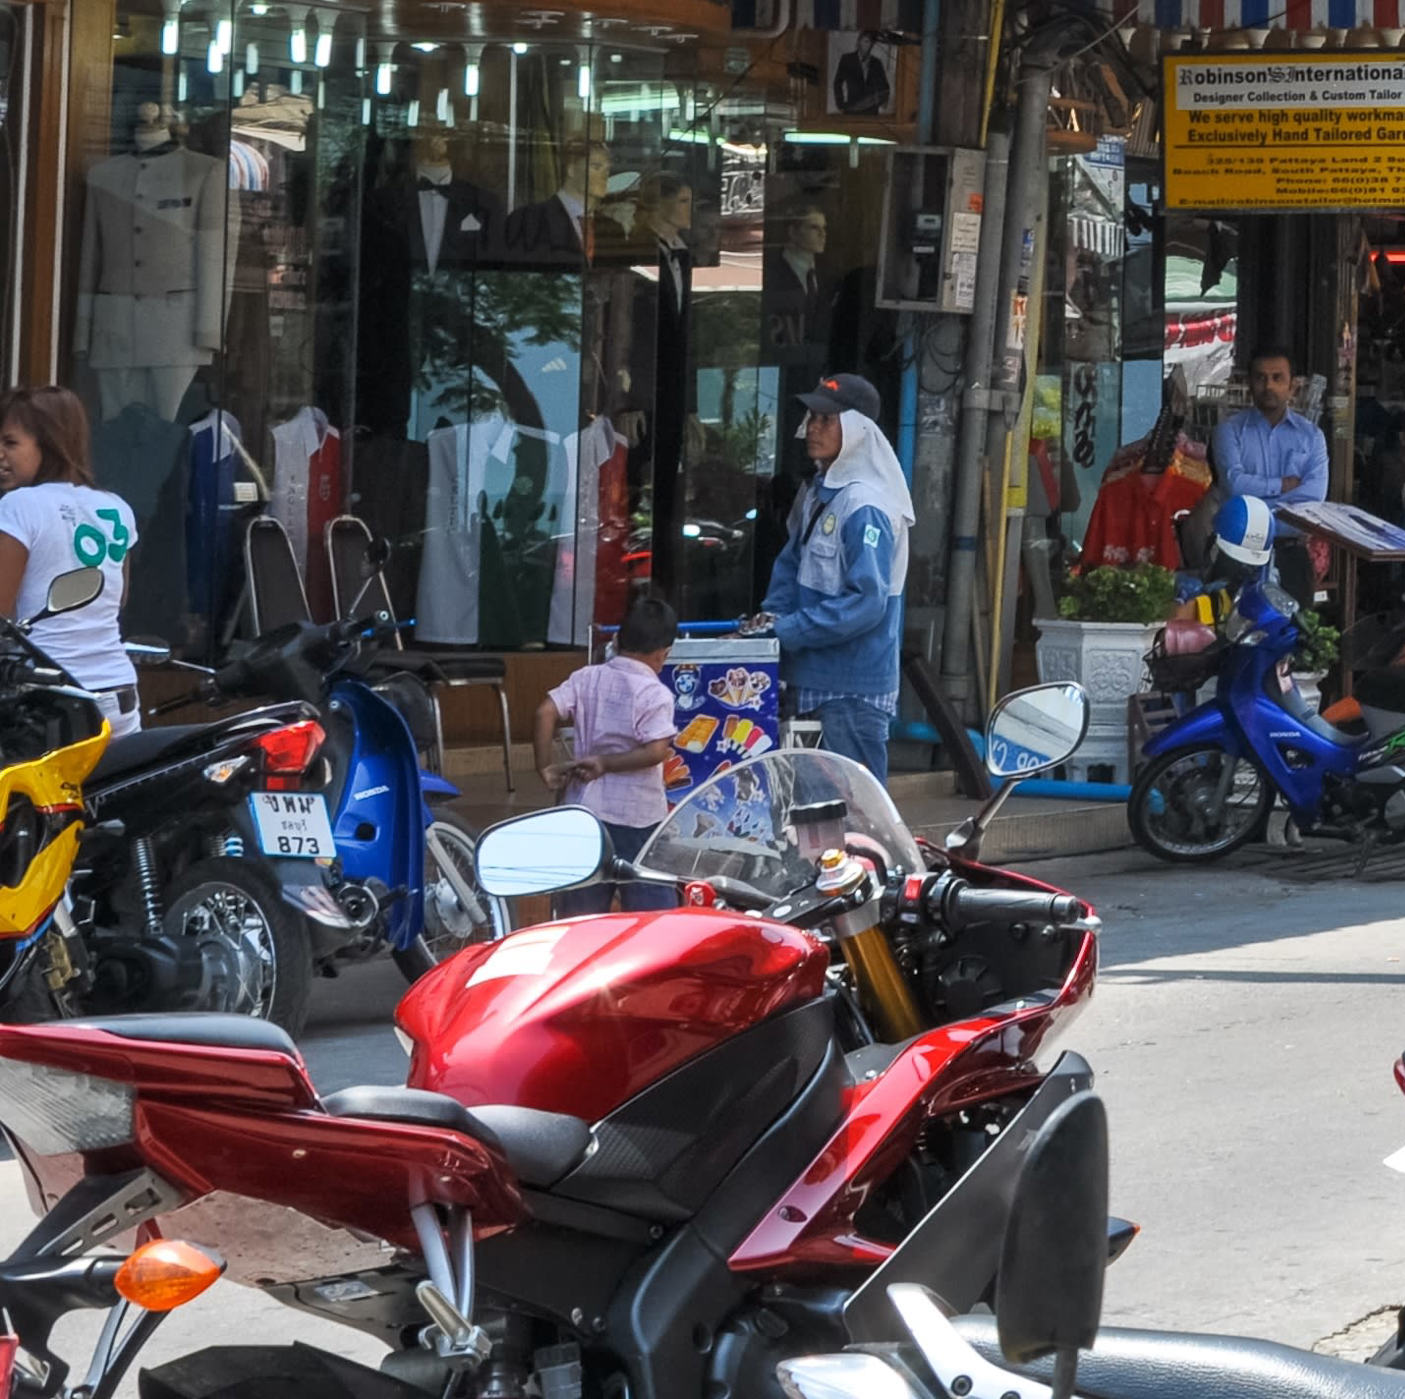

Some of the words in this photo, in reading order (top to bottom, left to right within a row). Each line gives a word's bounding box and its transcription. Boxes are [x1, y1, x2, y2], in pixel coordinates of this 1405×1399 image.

[1193, 92, 1244, 105] Designer
[1247, 90, 1305, 102] Collection
[1322, 90, 1365, 101] Custom
[1369, 89, 1402, 100] Tailor
[1188, 110, 1210, 123] We
[1214, 112, 1253, 123] serve
[1258, 109, 1290, 125] high
[1293, 108, 1342, 125] quality
[1187, 129, 1267, 146] Exclusively
[1272, 128, 1310, 142] Hand
[1313, 127, 1372, 142] Tailored
[277, 836, 320, 854] 873
